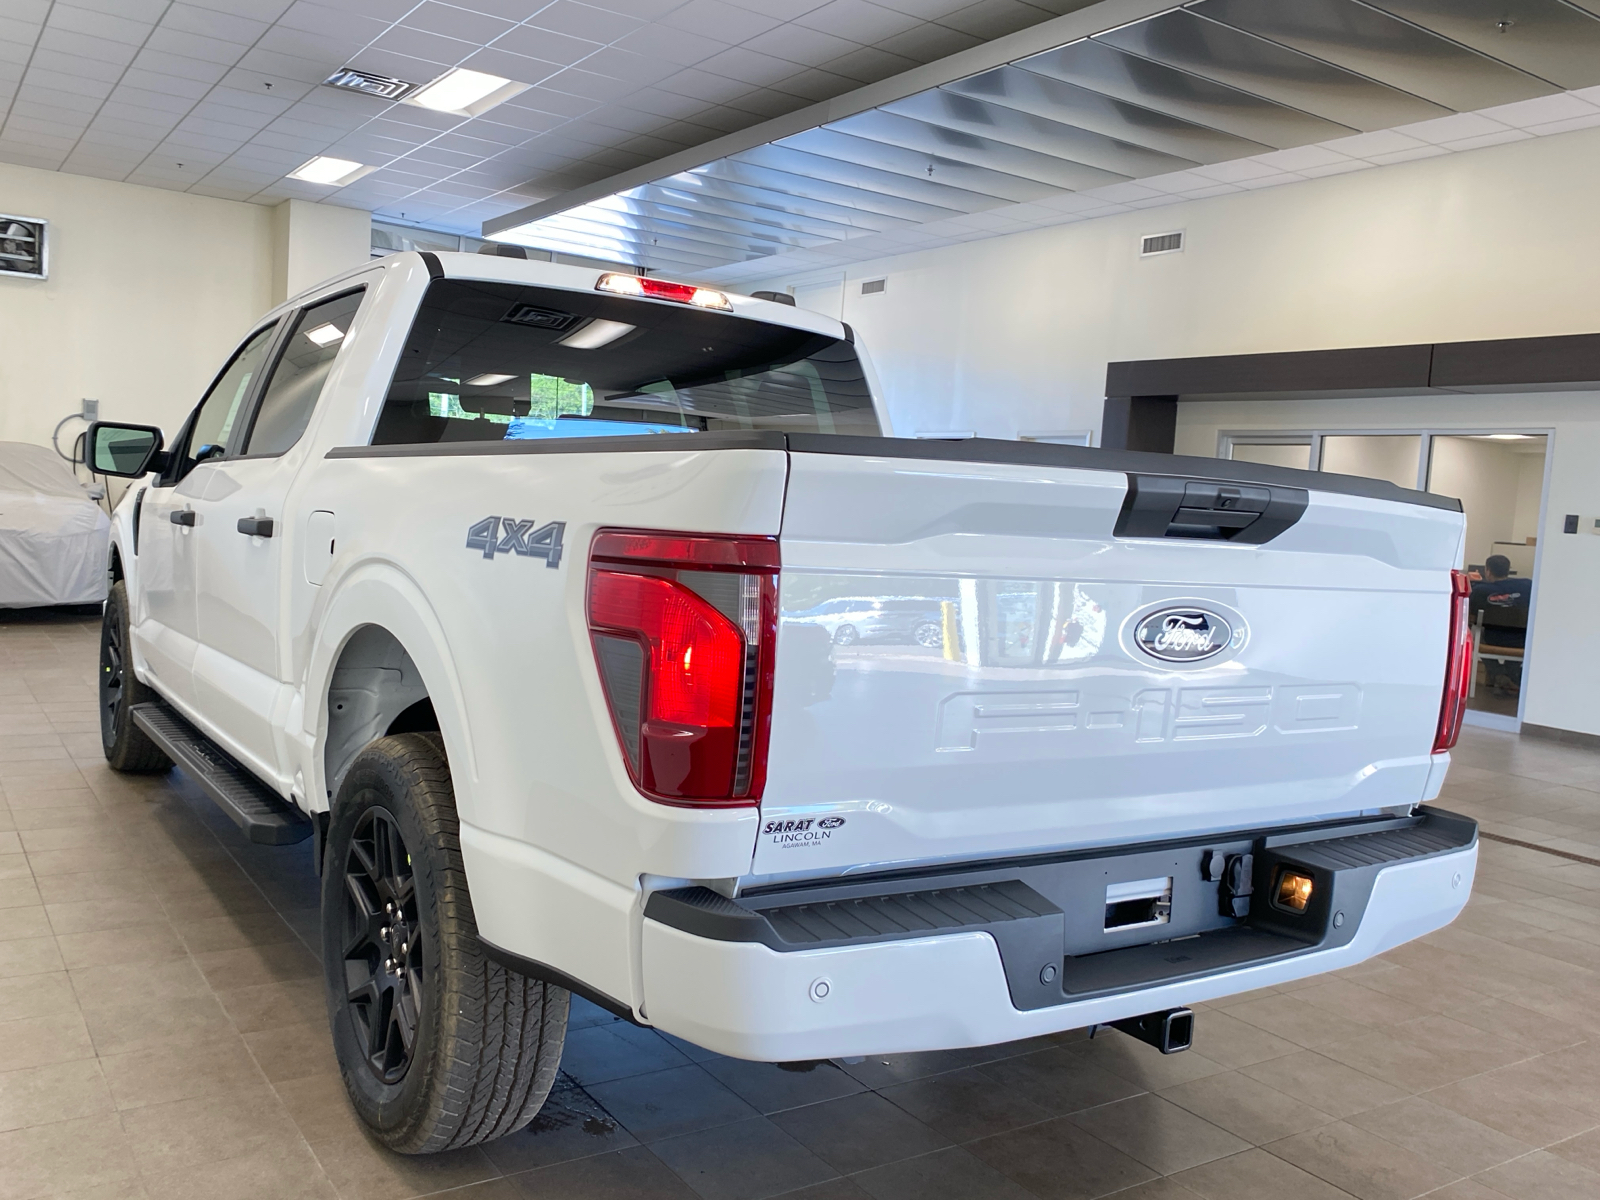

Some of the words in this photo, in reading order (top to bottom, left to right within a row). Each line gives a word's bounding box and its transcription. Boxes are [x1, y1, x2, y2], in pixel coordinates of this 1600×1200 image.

[1154, 615, 1216, 651] Ford
[935, 682, 1364, 752] F-150
[764, 819, 815, 834] SARAT
[773, 831, 831, 843] LINCOLN
